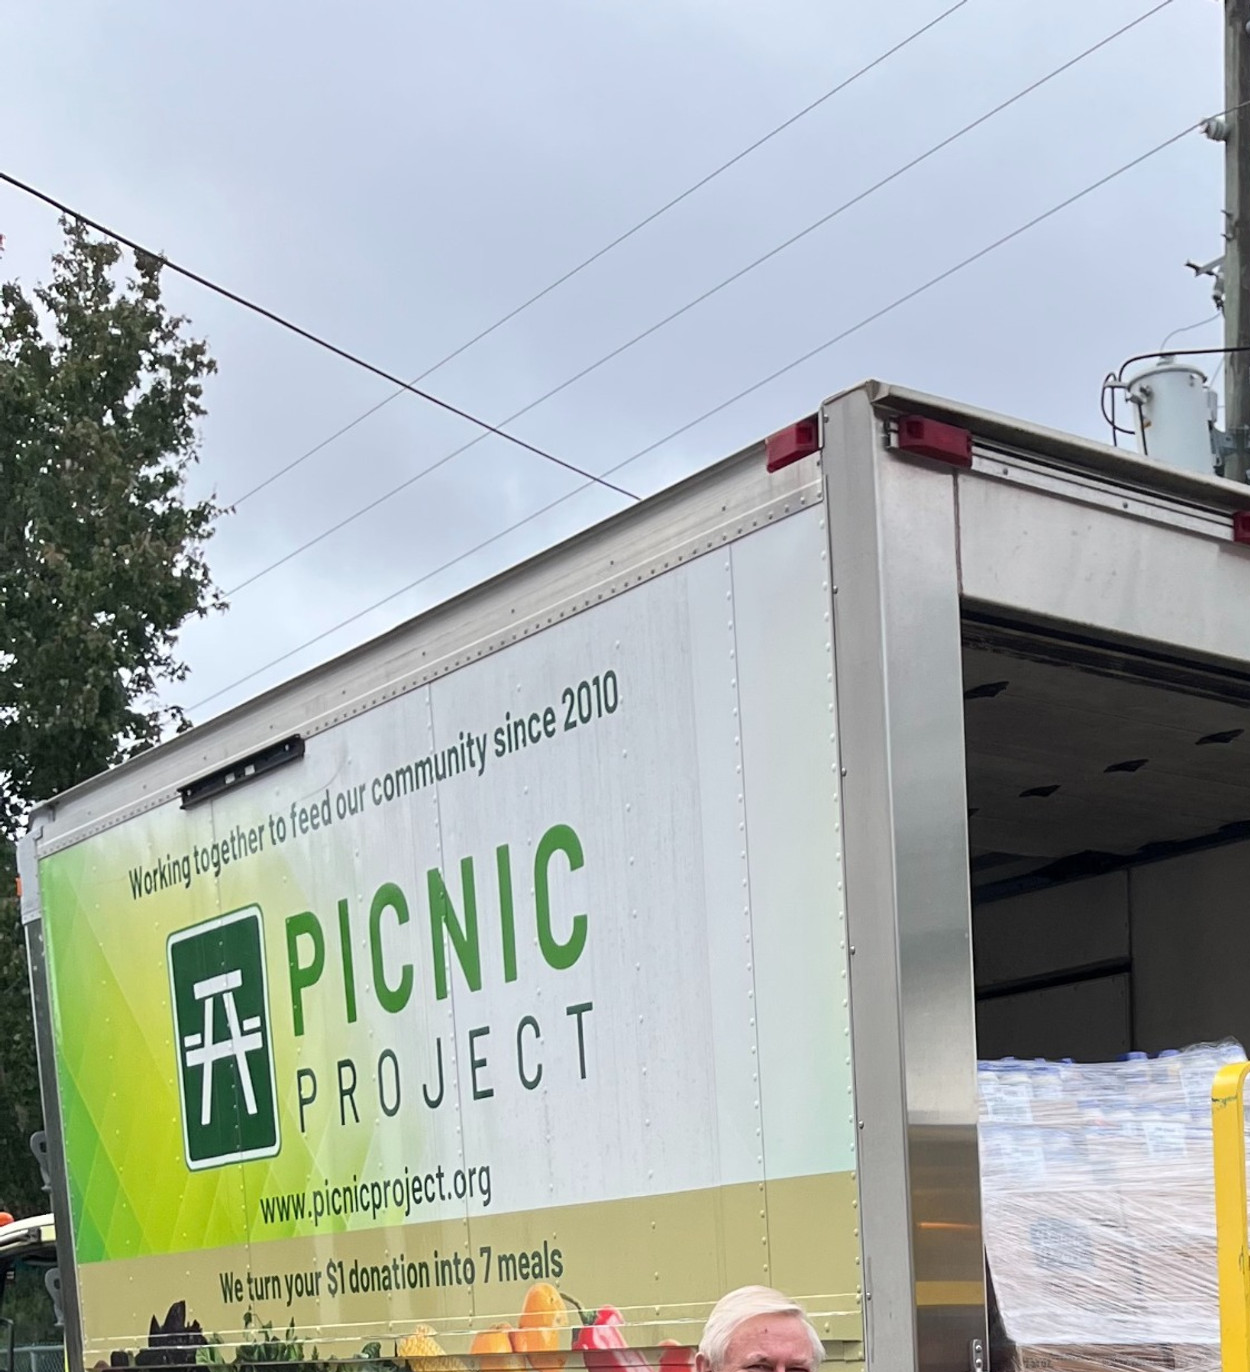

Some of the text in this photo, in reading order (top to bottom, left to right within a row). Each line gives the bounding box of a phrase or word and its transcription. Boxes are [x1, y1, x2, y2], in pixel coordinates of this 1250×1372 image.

[128, 669, 619, 900] Working together to feed our community since 2010
[285, 823, 588, 1037] PICNIC
[296, 1001, 593, 1133] PROJECT
[260, 1164, 491, 1226] www.picnicproject.org
[219, 1240, 564, 1306] We turn your $1 donation into 7 meals
